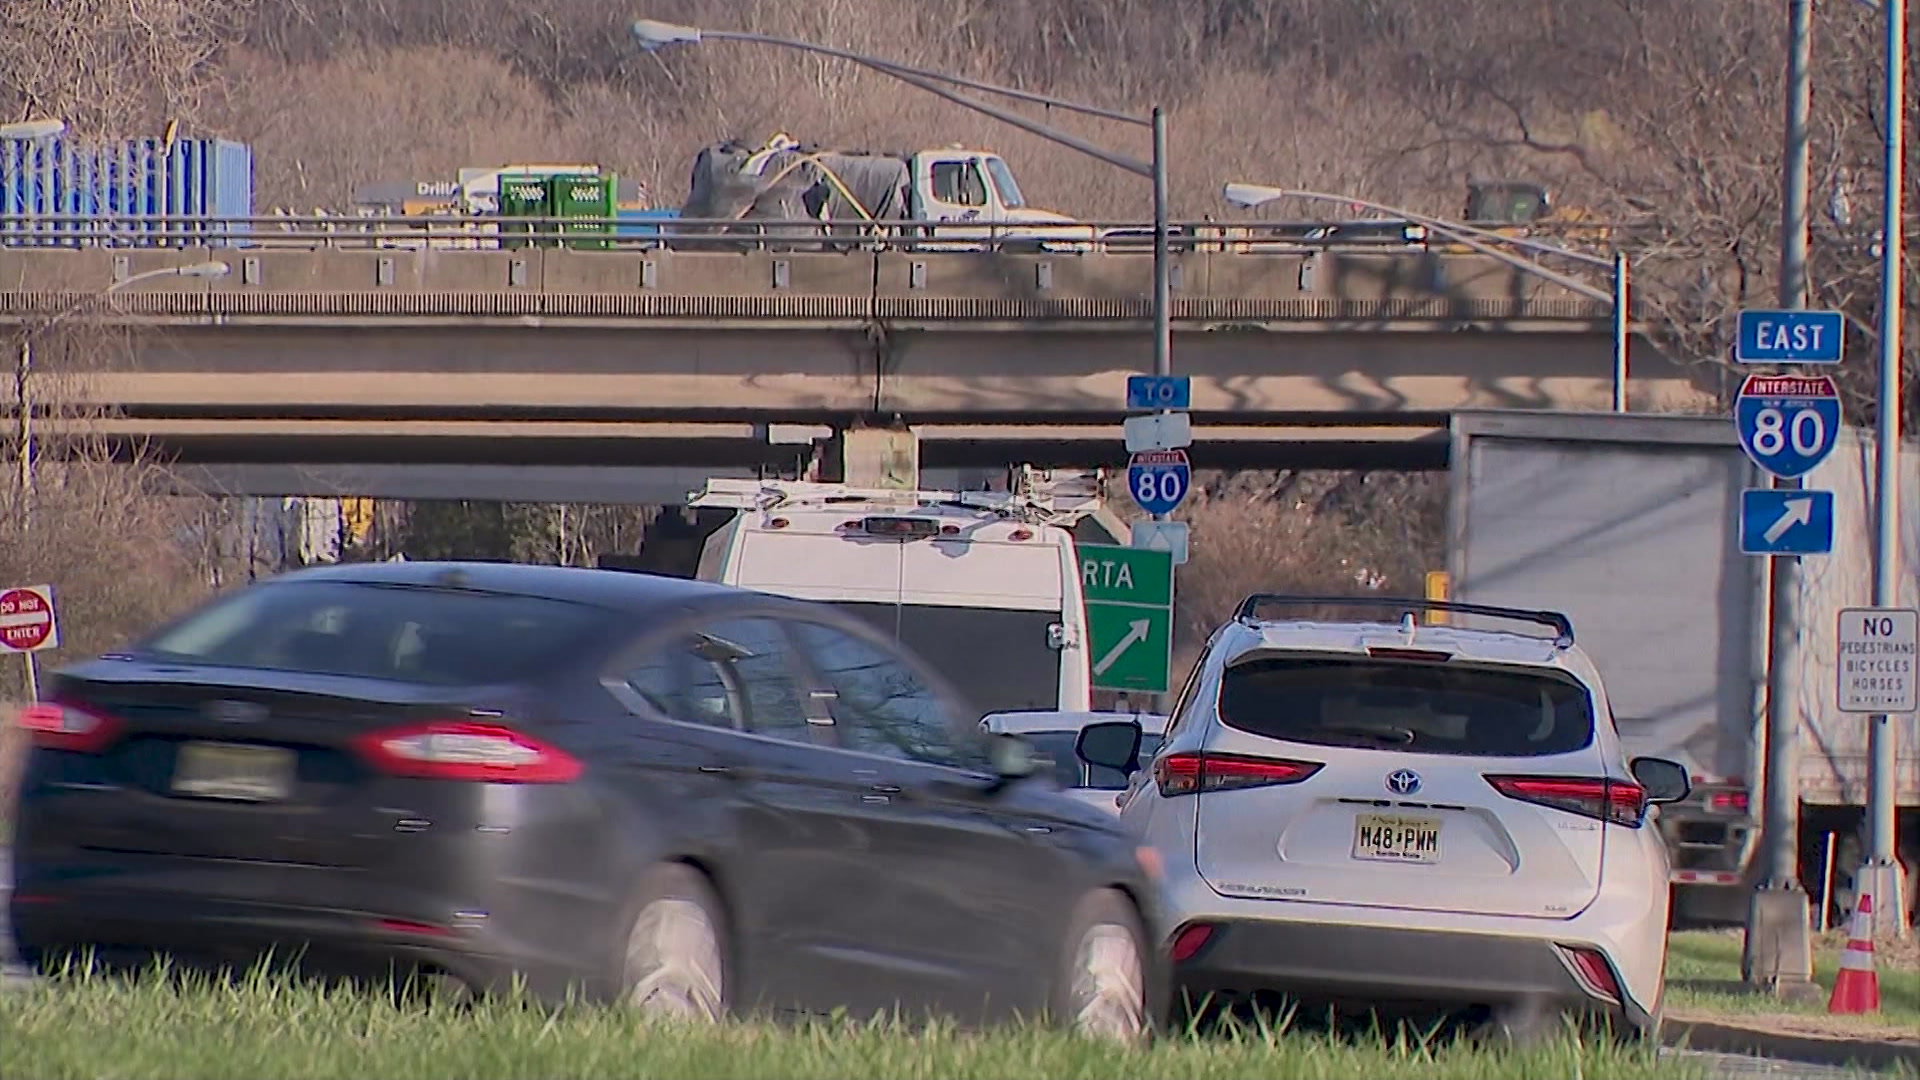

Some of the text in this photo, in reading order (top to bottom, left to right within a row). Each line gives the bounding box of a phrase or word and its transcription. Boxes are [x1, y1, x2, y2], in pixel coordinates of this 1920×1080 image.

[1757, 321, 1824, 350] EAST
[1144, 381, 1174, 401] TO
[1754, 380, 1826, 395] INTERSTATE
[1753, 408, 1825, 457] 80
[1138, 472, 1181, 503] 80
[1082, 560, 1134, 590] RTA
[1, 598, 39, 613] DO NOT
[6, 626, 40, 640] ENTER
[1863, 617, 1893, 637] NO
[1840, 641, 1915, 655] PEDESTRIANS
[1846, 660, 1909, 673] BICYCLES
[1852, 678, 1903, 691] HORSES
